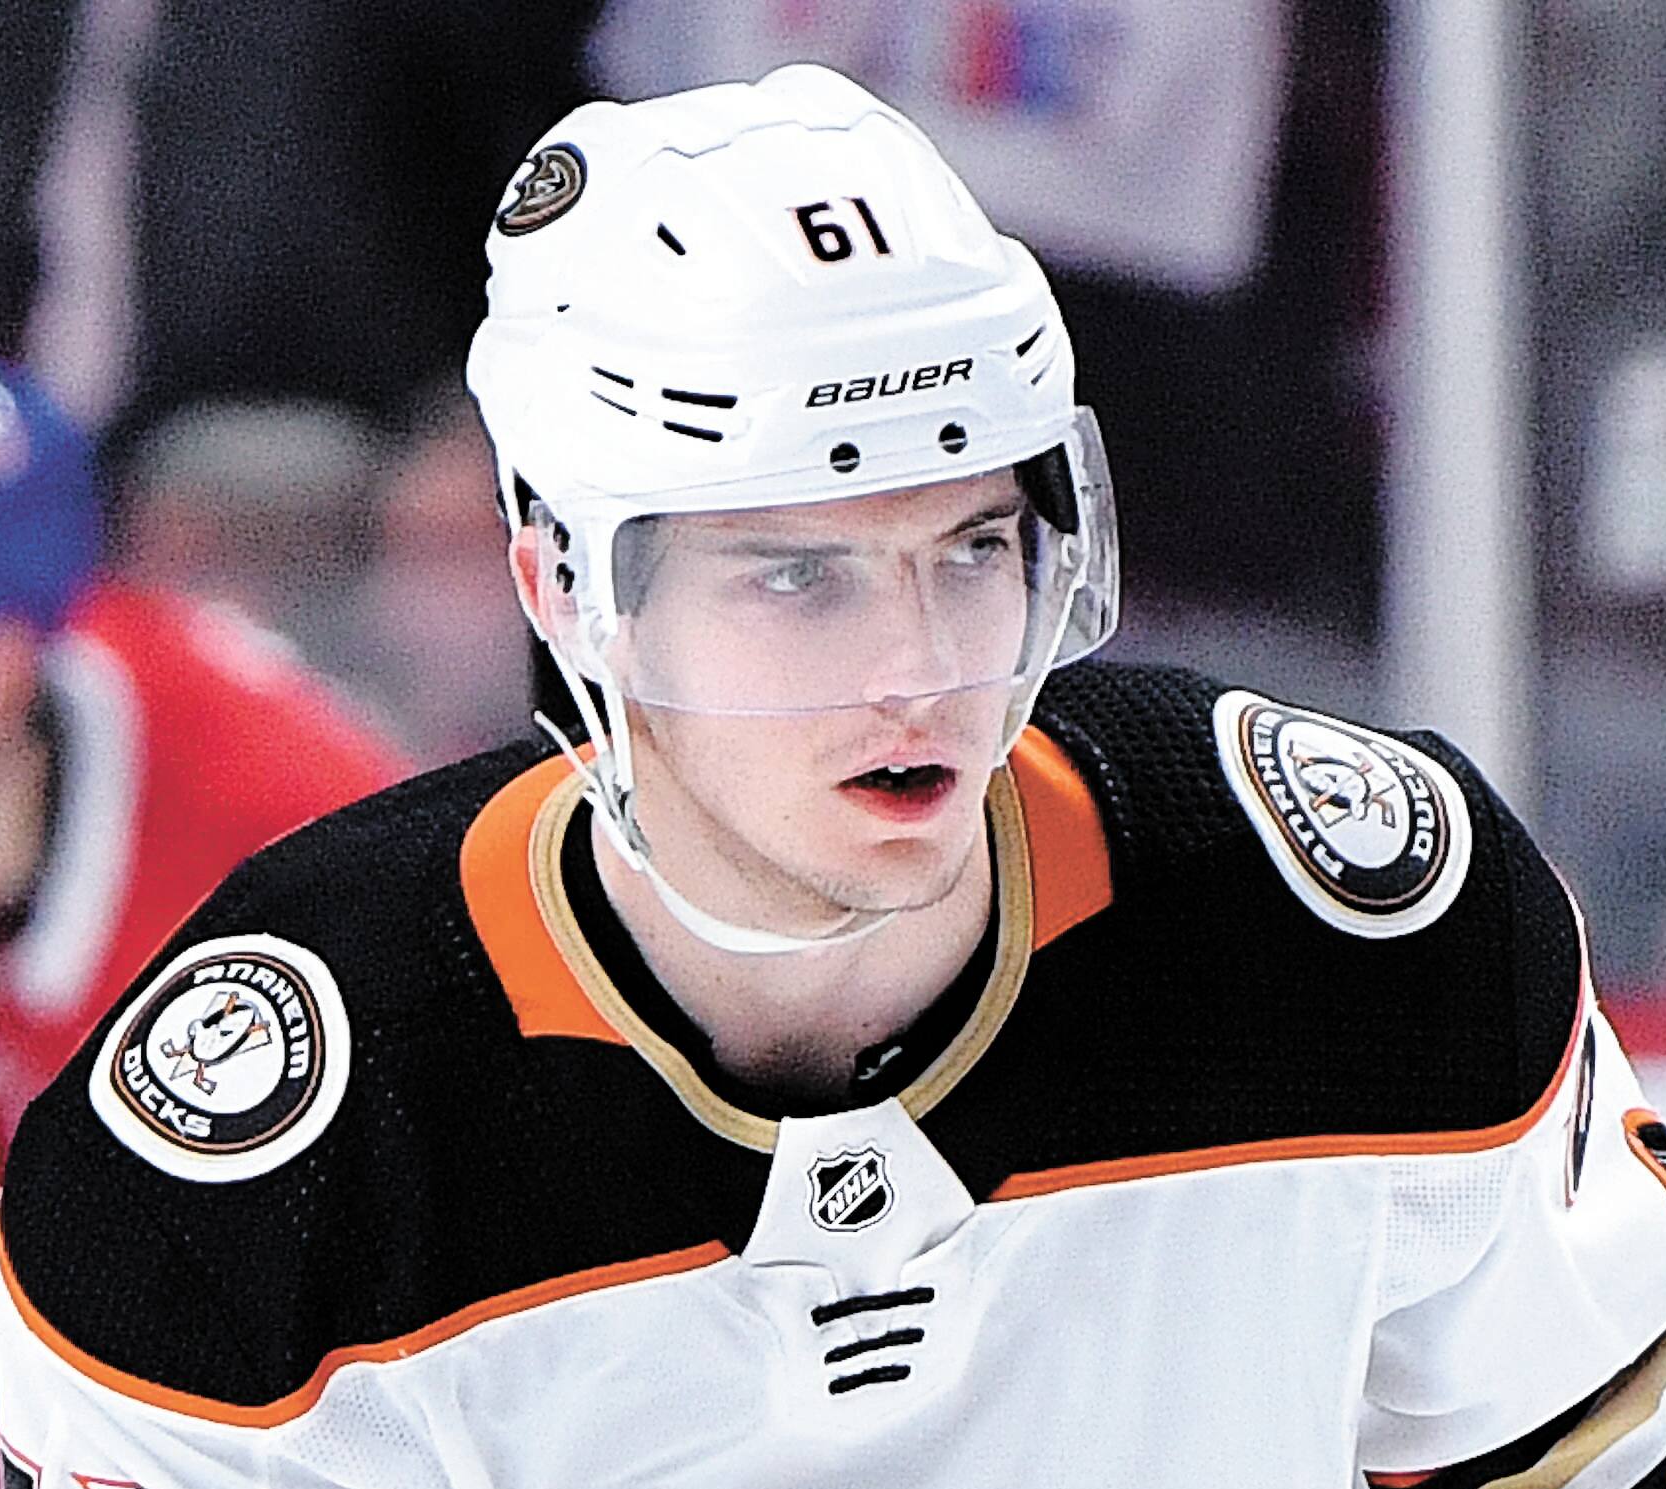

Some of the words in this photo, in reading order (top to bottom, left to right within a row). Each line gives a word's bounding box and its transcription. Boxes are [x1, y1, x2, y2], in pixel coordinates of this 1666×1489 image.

[786, 197, 893, 266] 61
[193, 962, 310, 1079] ANAHEIM
[123, 1043, 213, 1139] DUCKS
[826, 1164, 879, 1222] NHL
